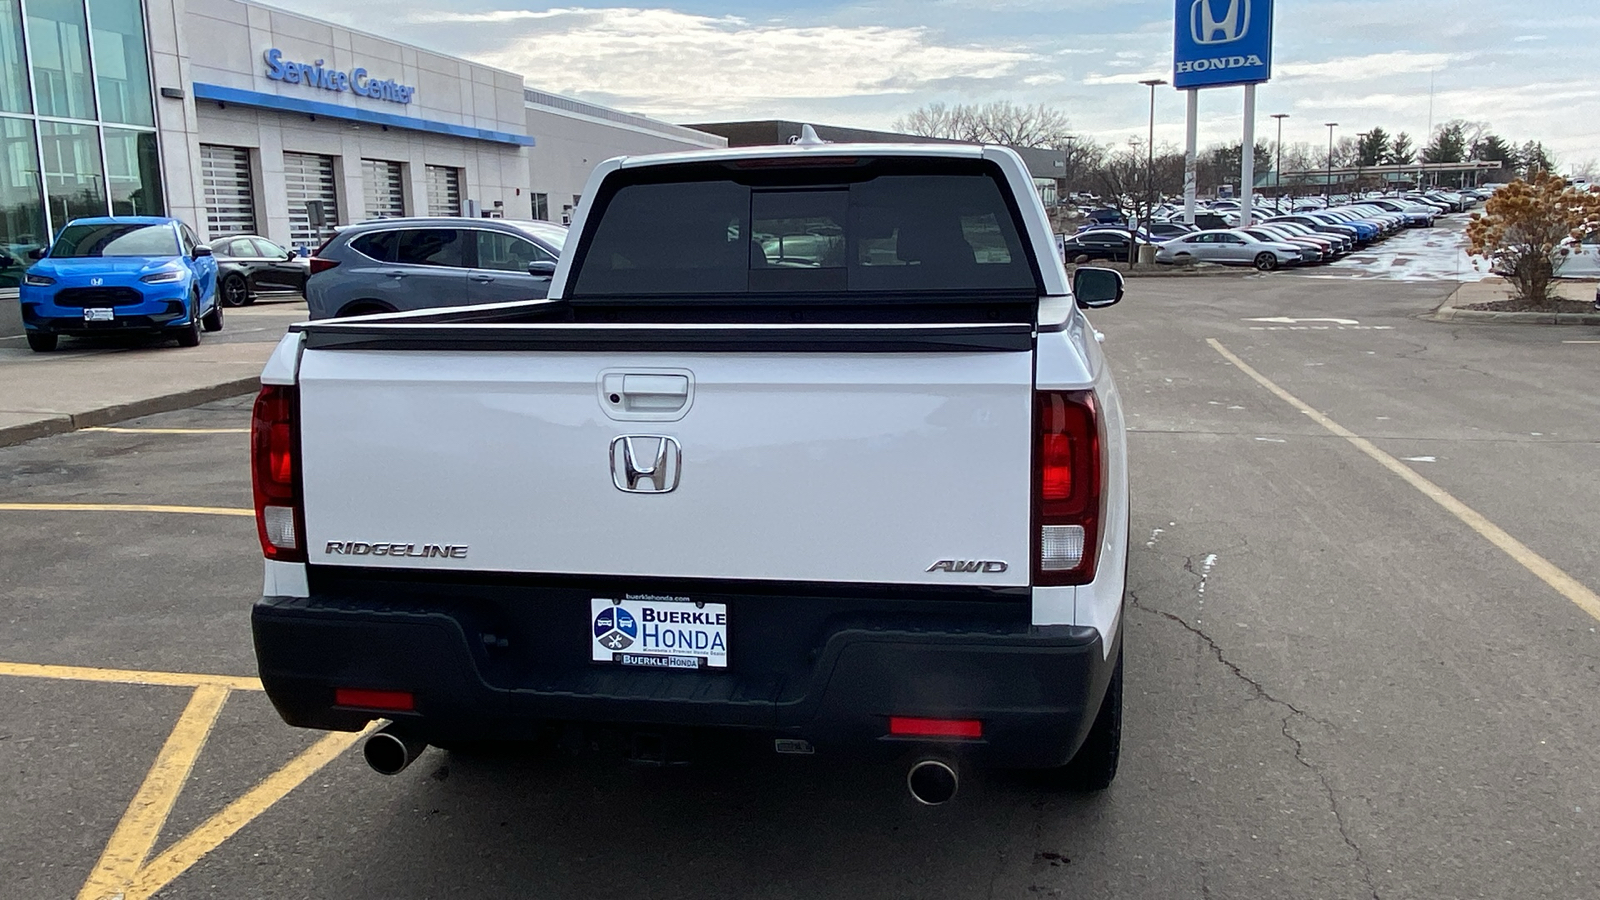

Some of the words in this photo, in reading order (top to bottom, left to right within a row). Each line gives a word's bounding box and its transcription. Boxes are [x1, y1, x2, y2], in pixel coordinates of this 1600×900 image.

[1176, 55, 1263, 73] HONDA
[263, 48, 348, 92] Service
[350, 67, 415, 104] Center
[325, 540, 469, 559] RIDGELINE
[924, 558, 1009, 573] AWD
[625, 593, 690, 601] buerklehonda.com
[642, 607, 726, 625] BUERKLE
[643, 623, 725, 651] HONDA
[623, 655, 667, 666] BUERKLE
[669, 656, 697, 667] HONDA
